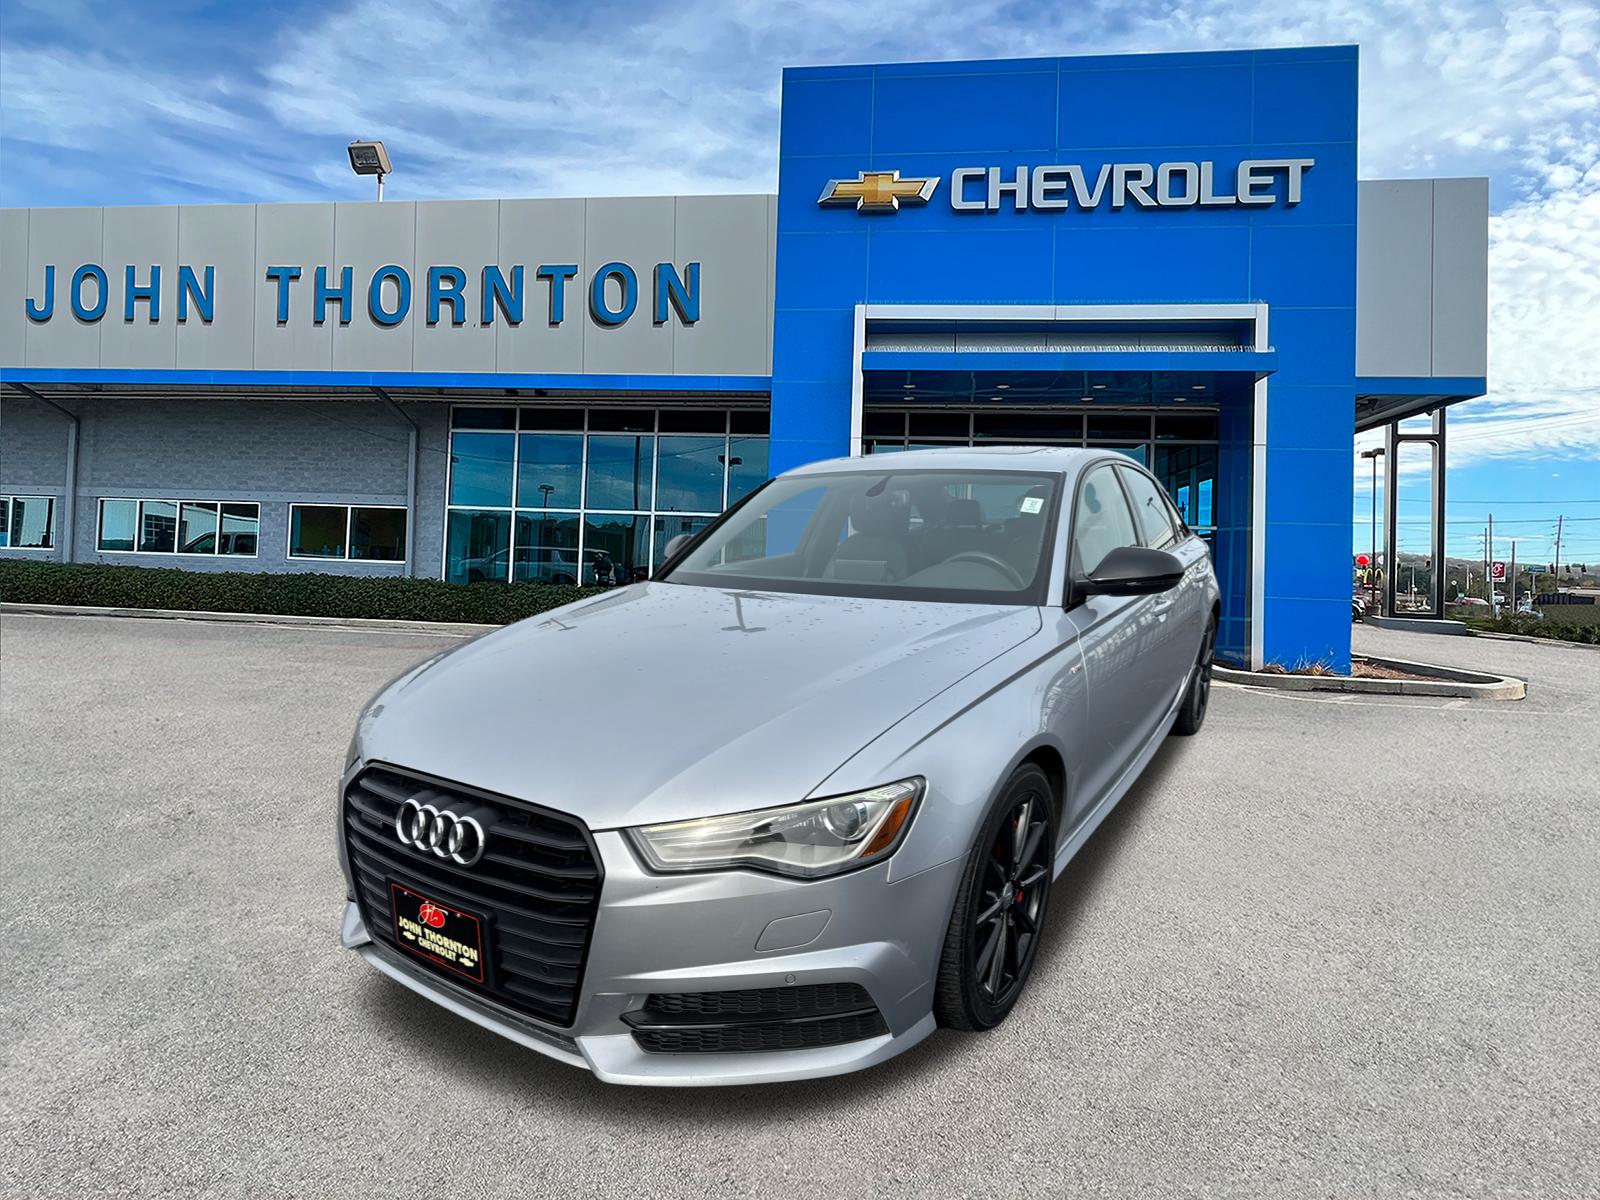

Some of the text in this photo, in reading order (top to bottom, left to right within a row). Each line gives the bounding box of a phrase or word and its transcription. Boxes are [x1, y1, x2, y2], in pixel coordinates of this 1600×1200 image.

[951, 158, 1315, 210] CHEVROLET
[25, 262, 701, 326] JOHN THORNTON
[399, 916, 478, 961] JOHN THORNTON
[418, 937, 456, 961] CHEVROLET
